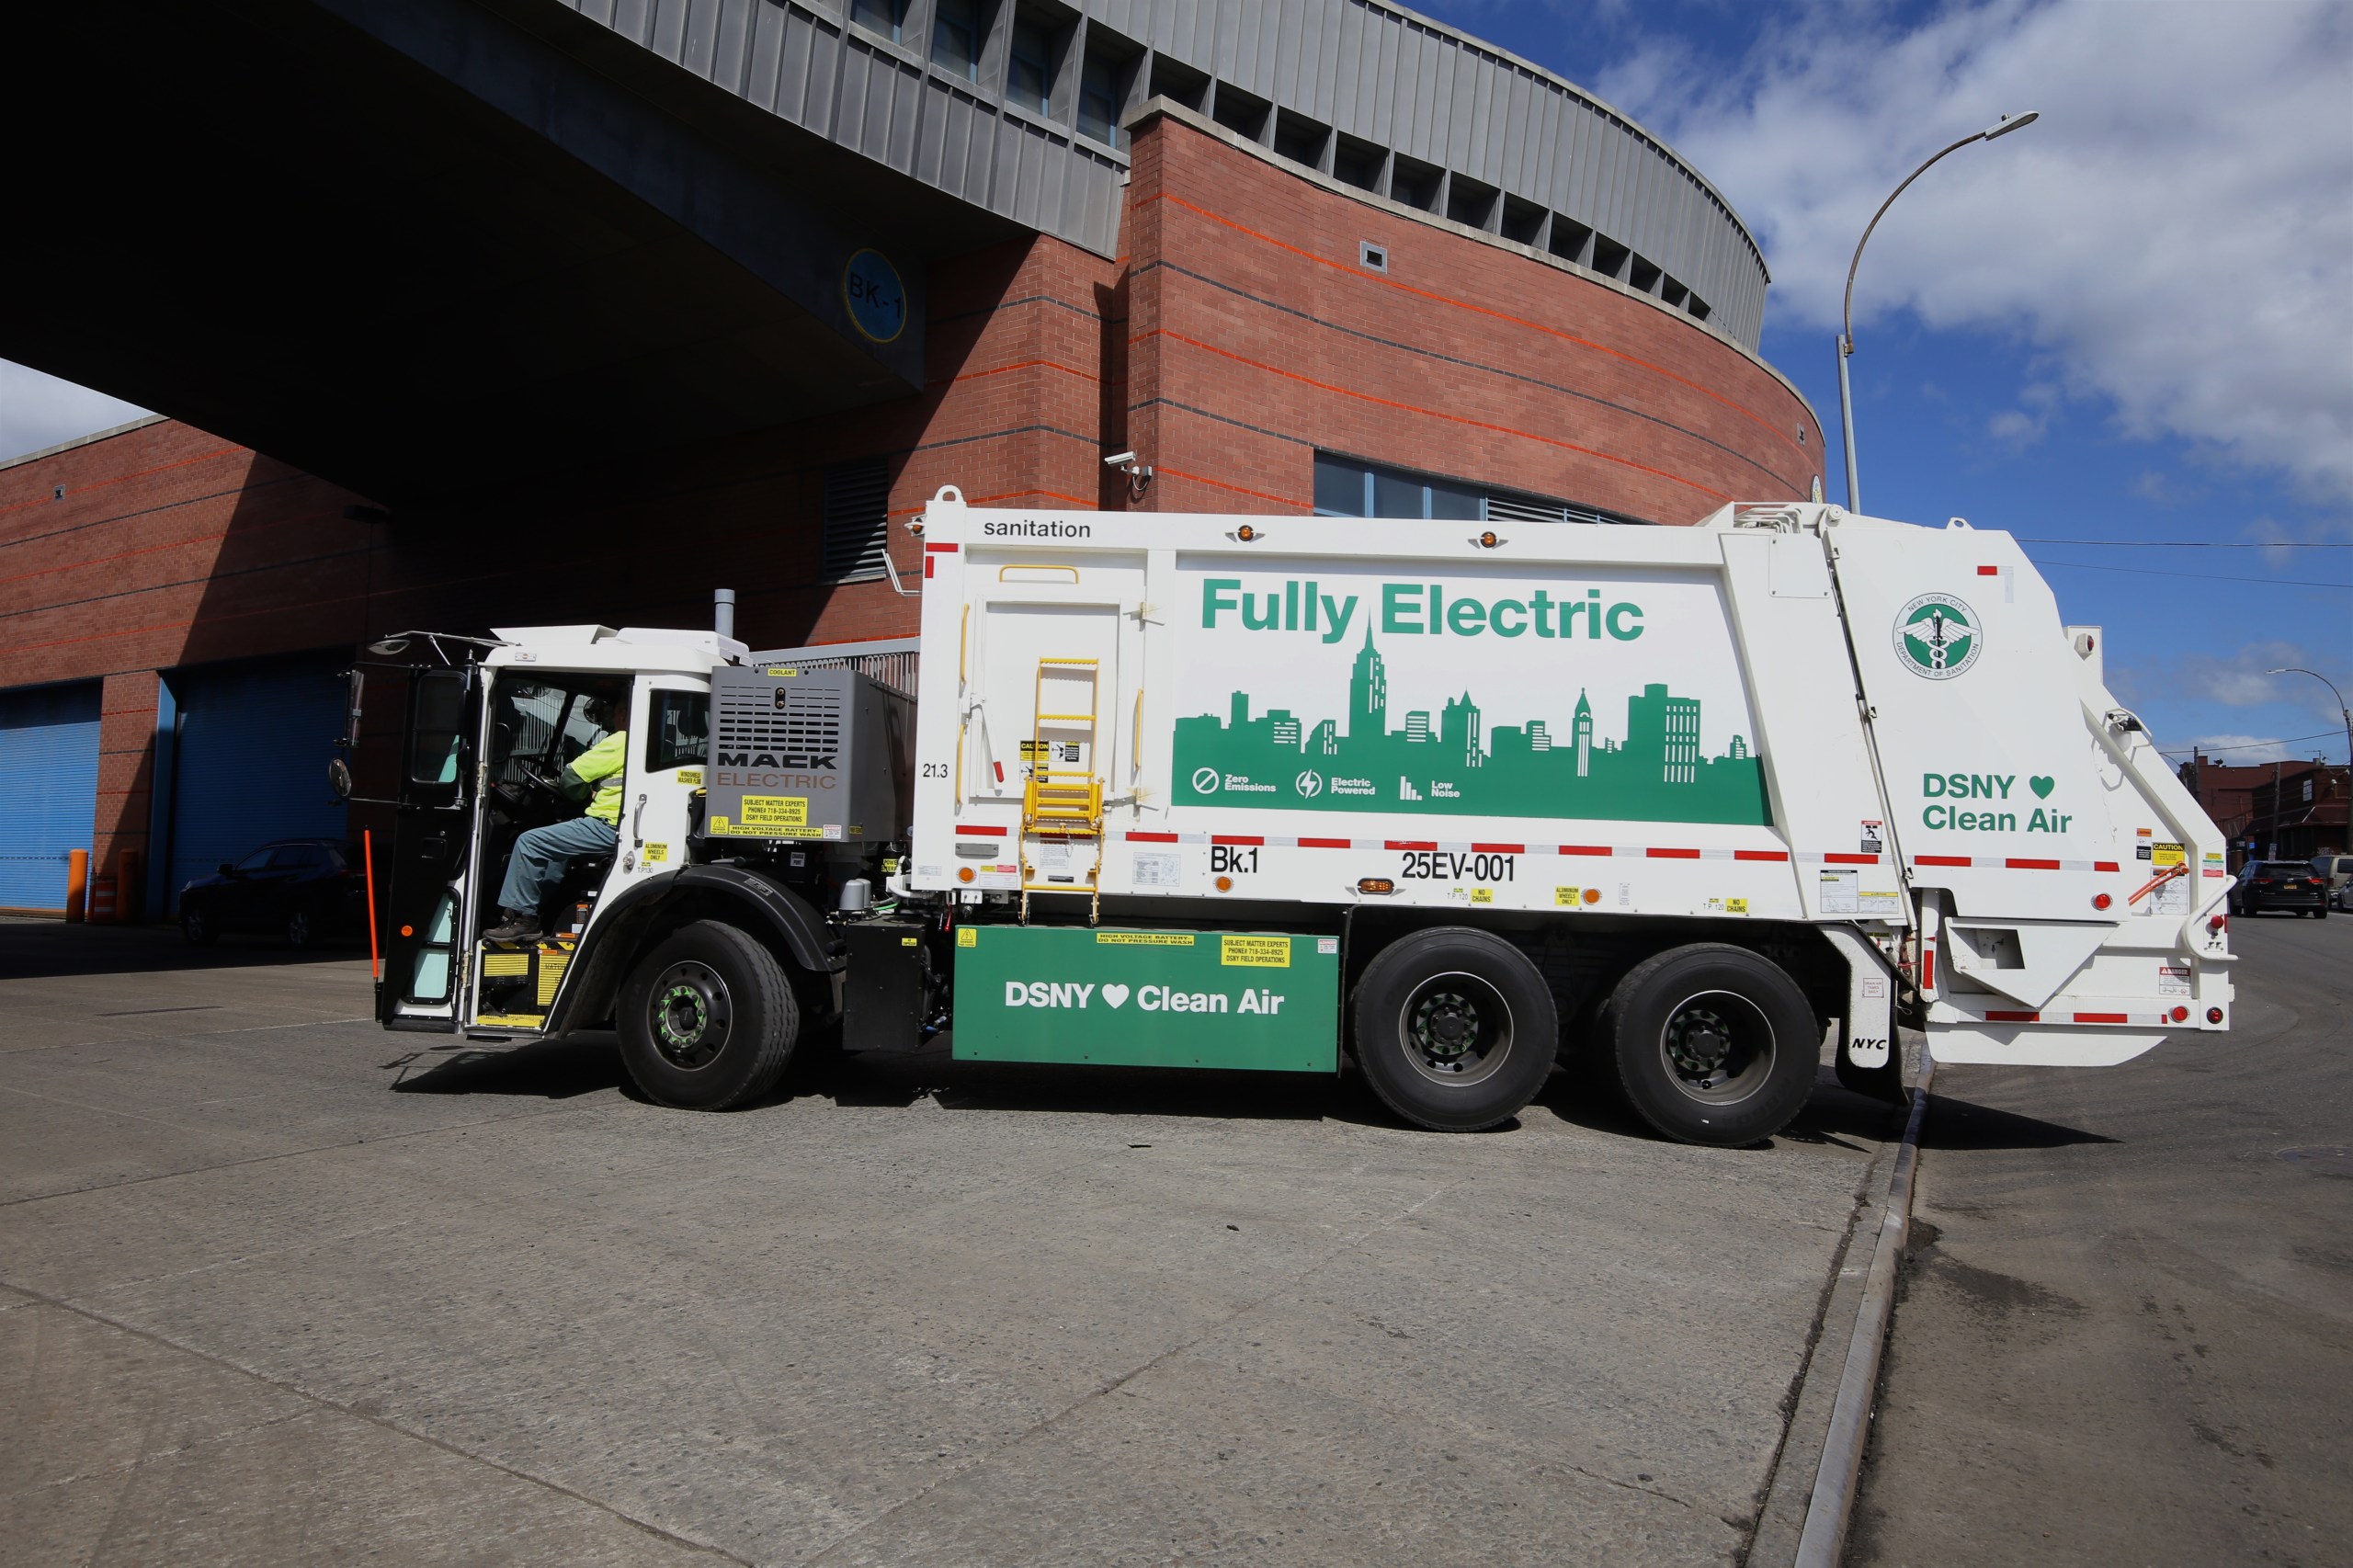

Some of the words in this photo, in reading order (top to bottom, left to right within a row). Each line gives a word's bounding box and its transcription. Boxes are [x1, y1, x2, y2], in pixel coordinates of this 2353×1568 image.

[849, 272, 902, 319] BK-1
[983, 519, 1091, 538] sanitation
[1202, 578, 1358, 644] Fully
[1381, 583, 1644, 642] Electric
[1908, 599, 1924, 612] NEW
[1949, 599, 1967, 612] CITY
[1896, 642, 1932, 676] DEPARTMENT
[1946, 643, 1979, 676] SANITATION
[717, 752, 837, 770] MACK
[923, 764, 949, 778] 21.3
[1224, 774, 1249, 783] Zero
[717, 772, 836, 790] ELECTRIC
[1224, 782, 1277, 792] Emissions
[1331, 777, 1370, 788] Electric
[1431, 779, 1453, 790] Low
[1923, 773, 2016, 800] DSNY
[1331, 786, 1376, 795] Powered
[1431, 788, 1461, 798] Noise
[1922, 805, 2017, 832] Clean
[2027, 808, 2073, 834] Air
[1211, 846, 1257, 873] Bk.1
[1402, 852, 1514, 881] 25EV-001
[1005, 982, 1095, 1009] DSNY
[1137, 984, 1228, 1013] Clean
[1237, 988, 1284, 1015] Air
[1852, 1038, 1887, 1050] NYC
